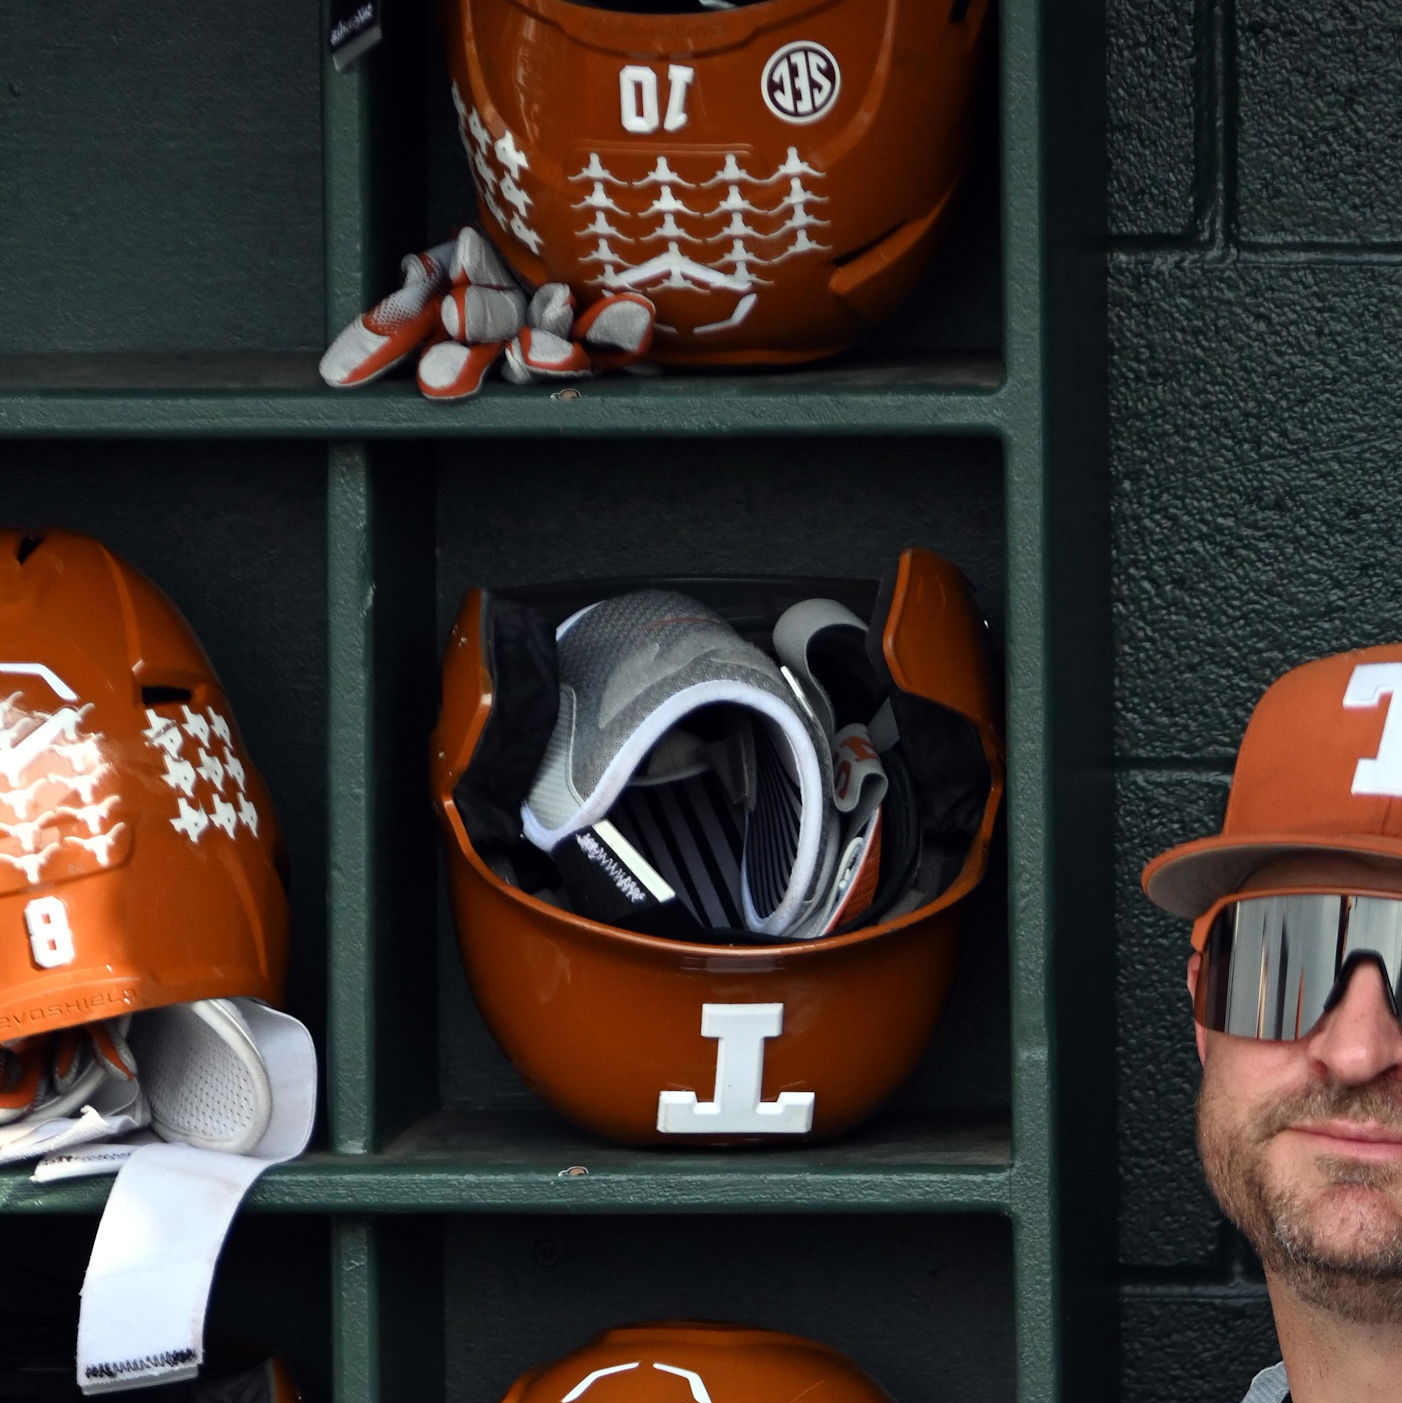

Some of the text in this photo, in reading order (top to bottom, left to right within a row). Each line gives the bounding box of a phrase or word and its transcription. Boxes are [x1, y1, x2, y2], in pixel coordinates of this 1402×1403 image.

[619, 64, 695, 135] 10
[770, 50, 832, 114] SEC
[24, 895, 76, 969] 8
[656, 1002, 816, 1134] T
